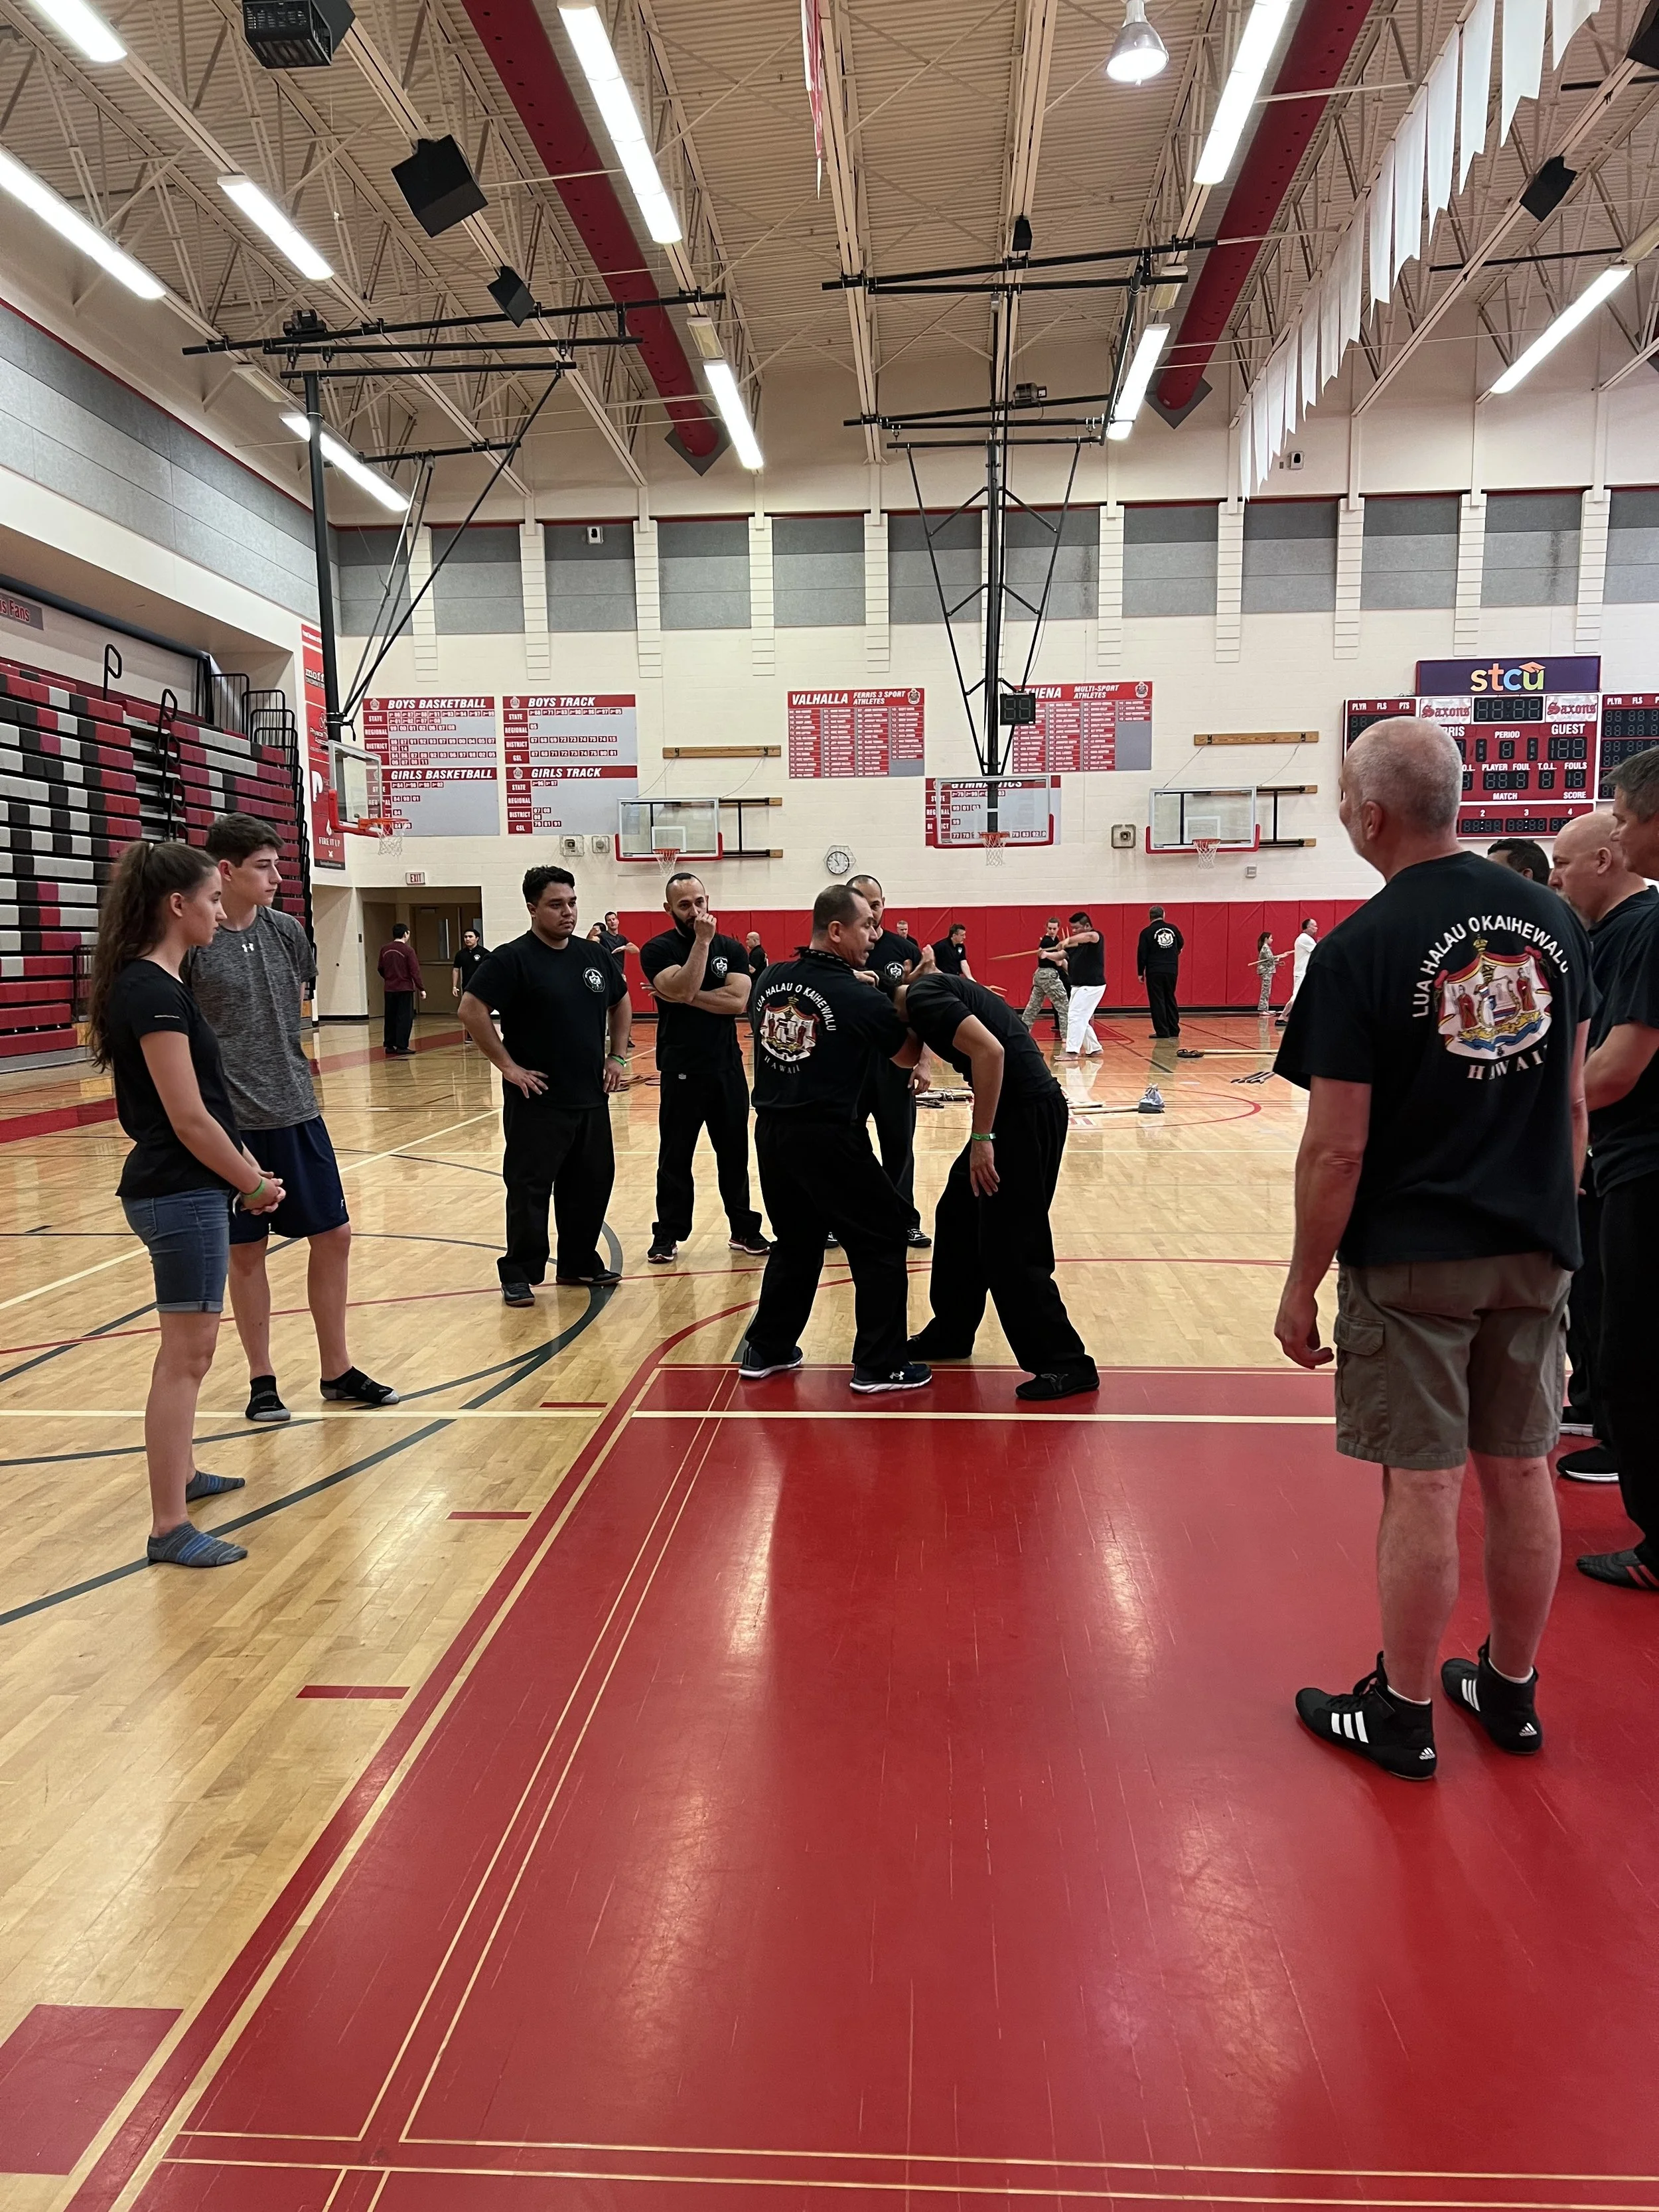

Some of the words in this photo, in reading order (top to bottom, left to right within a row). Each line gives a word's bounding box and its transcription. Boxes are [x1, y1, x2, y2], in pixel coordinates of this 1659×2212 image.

[9, 599, 30, 622] Fans
[1470, 663, 1544, 692] stcu
[1019, 687, 1061, 699] THENA
[388, 700, 415, 709] BOYS
[419, 699, 486, 709] BASKETBALL
[528, 698, 556, 707] BOYS
[560, 697, 595, 706] TRACK
[792, 694, 848, 705] VALHALLA
[1421, 705, 1471, 717] Saxons
[1548, 701, 1597, 715] Saxons
[1443, 726, 1465, 736] RRIS
[1551, 724, 1585, 734] GUEST
[392, 771, 422, 779] GIRLS
[425, 770, 492, 779] BASKETBALL
[532, 769, 563, 778] GIRLS
[566, 768, 602, 777] TRACK
[410, 873, 421, 883] EXIT
[1420, 923, 1467, 976] HALAU
[1412, 979, 1433, 1018] LUA
[757, 995, 766, 1011] LUA
[765, 983, 793, 997] HALAU
[795, 984, 802, 993] O
[803, 987, 837, 1031] KAIHEWALU
